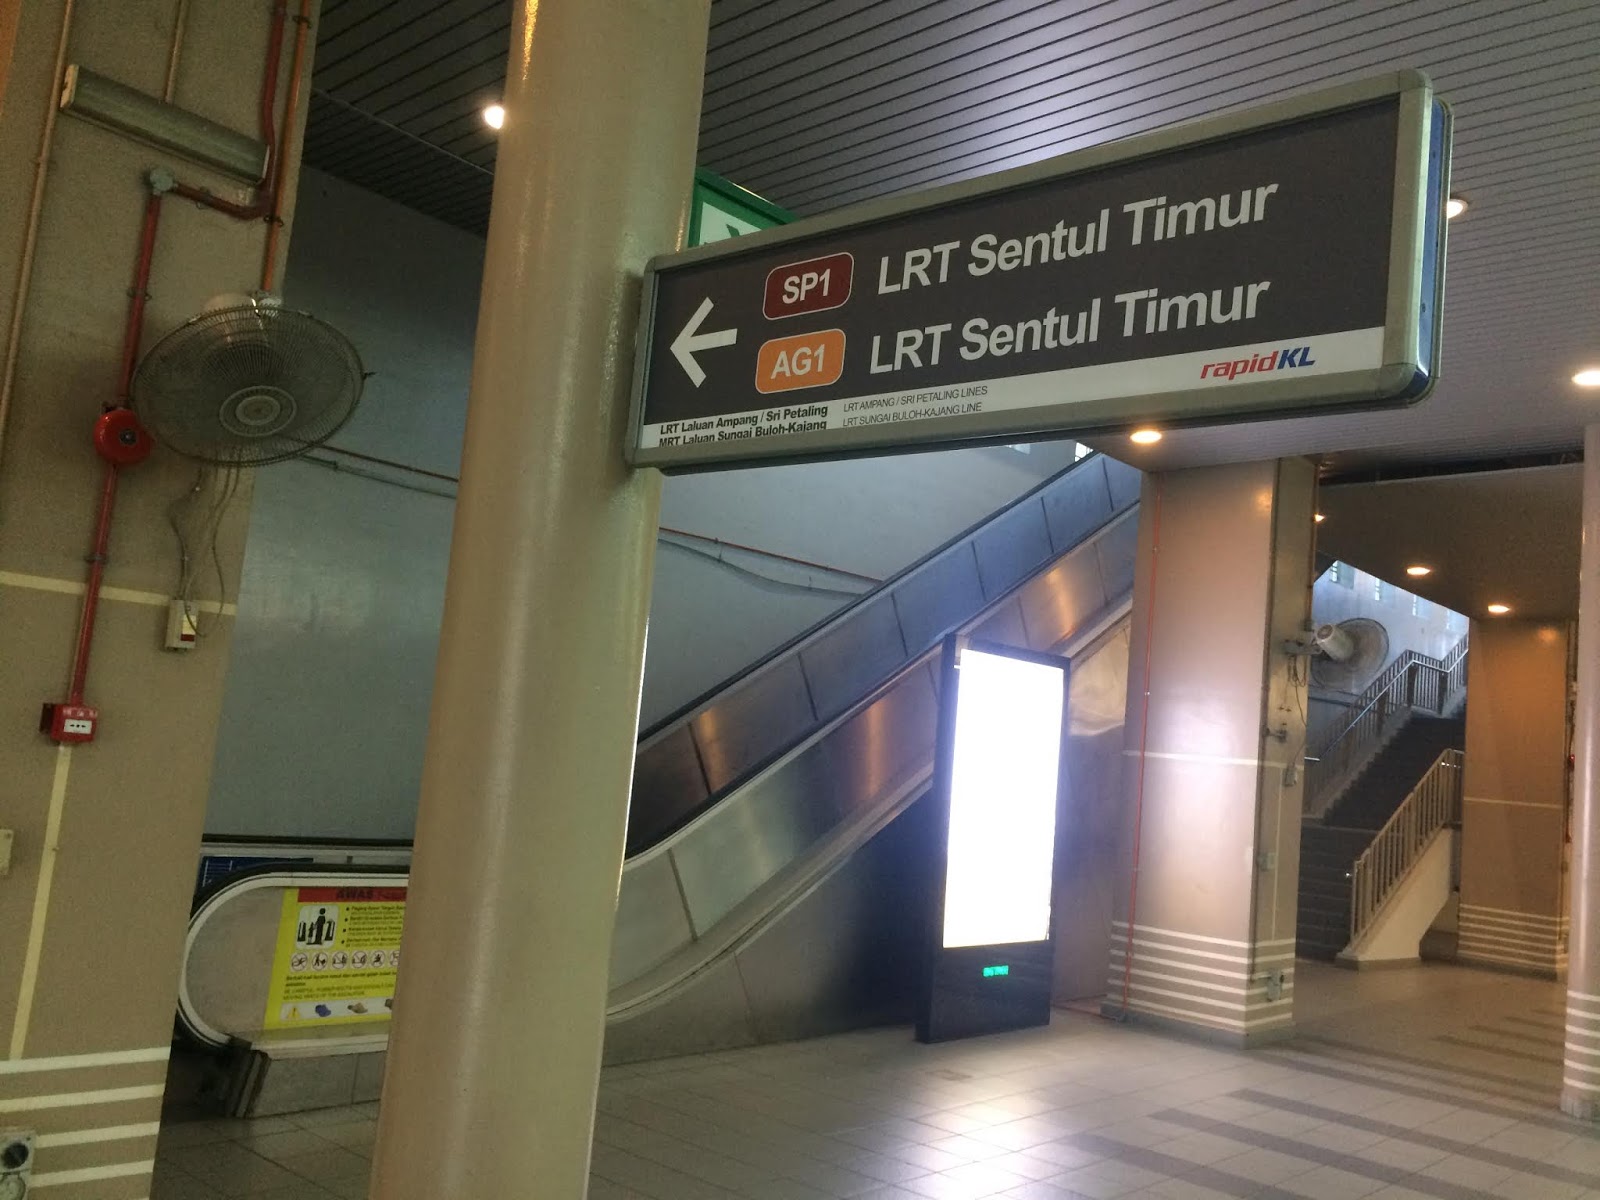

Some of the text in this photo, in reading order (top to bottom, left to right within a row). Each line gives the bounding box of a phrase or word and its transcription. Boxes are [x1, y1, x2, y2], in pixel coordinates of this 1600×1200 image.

[878, 182, 1280, 295] LRT Sentul Timur
[781, 268, 833, 305] SP1
[869, 281, 1272, 376] LRT Sentul Timur
[771, 344, 826, 380] AG1
[1200, 346, 1317, 382] rapidKL
[842, 402, 983, 427] LRT SUNGAI BULOH-KAJANG LINE
[843, 401, 860, 412] LRT
[860, 397, 895, 410] AMPANG
[900, 394, 916, 406] SRI
[917, 388, 960, 403] PETALING
[960, 385, 989, 398] LINES
[659, 420, 828, 447] MRT Laluan Sungai Buloh-Kajang
[660, 423, 680, 435] LRT
[681, 420, 714, 433] Laluan
[715, 415, 758, 429] Ampang
[766, 409, 781, 422] Sri
[783, 404, 828, 420] Petaling
